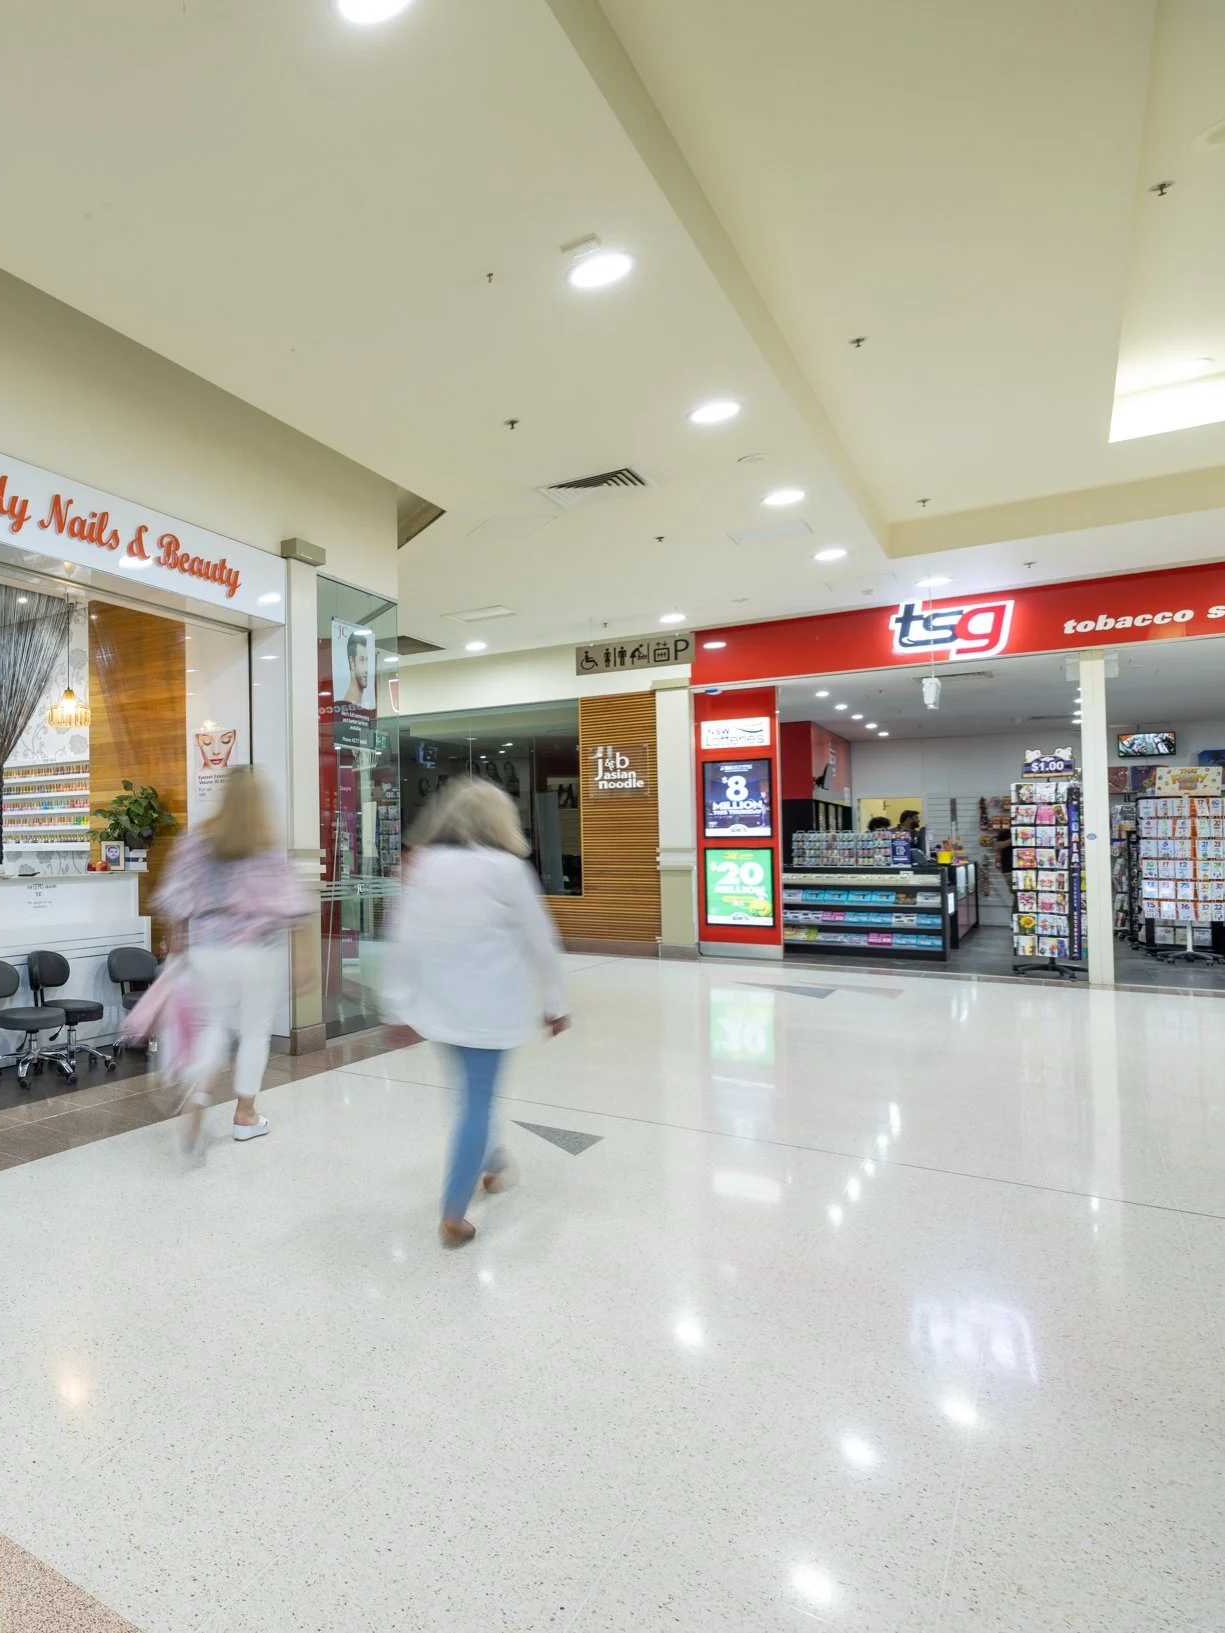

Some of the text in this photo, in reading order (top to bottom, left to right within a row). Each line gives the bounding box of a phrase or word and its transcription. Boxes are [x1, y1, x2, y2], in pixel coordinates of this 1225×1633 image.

[38, 494, 120, 550] Nails
[127, 525, 151, 560] &
[155, 533, 241, 597] Beauty
[1063, 609, 1194, 634] tobacco
[894, 603, 1007, 656] tsg
[674, 639, 689, 660] P
[706, 735, 765, 746] Lotteries
[1031, 761, 1064, 772] $1.00
[603, 769, 636, 779] asian
[599, 779, 644, 789] noodle
[712, 800, 763, 810] MILLION
